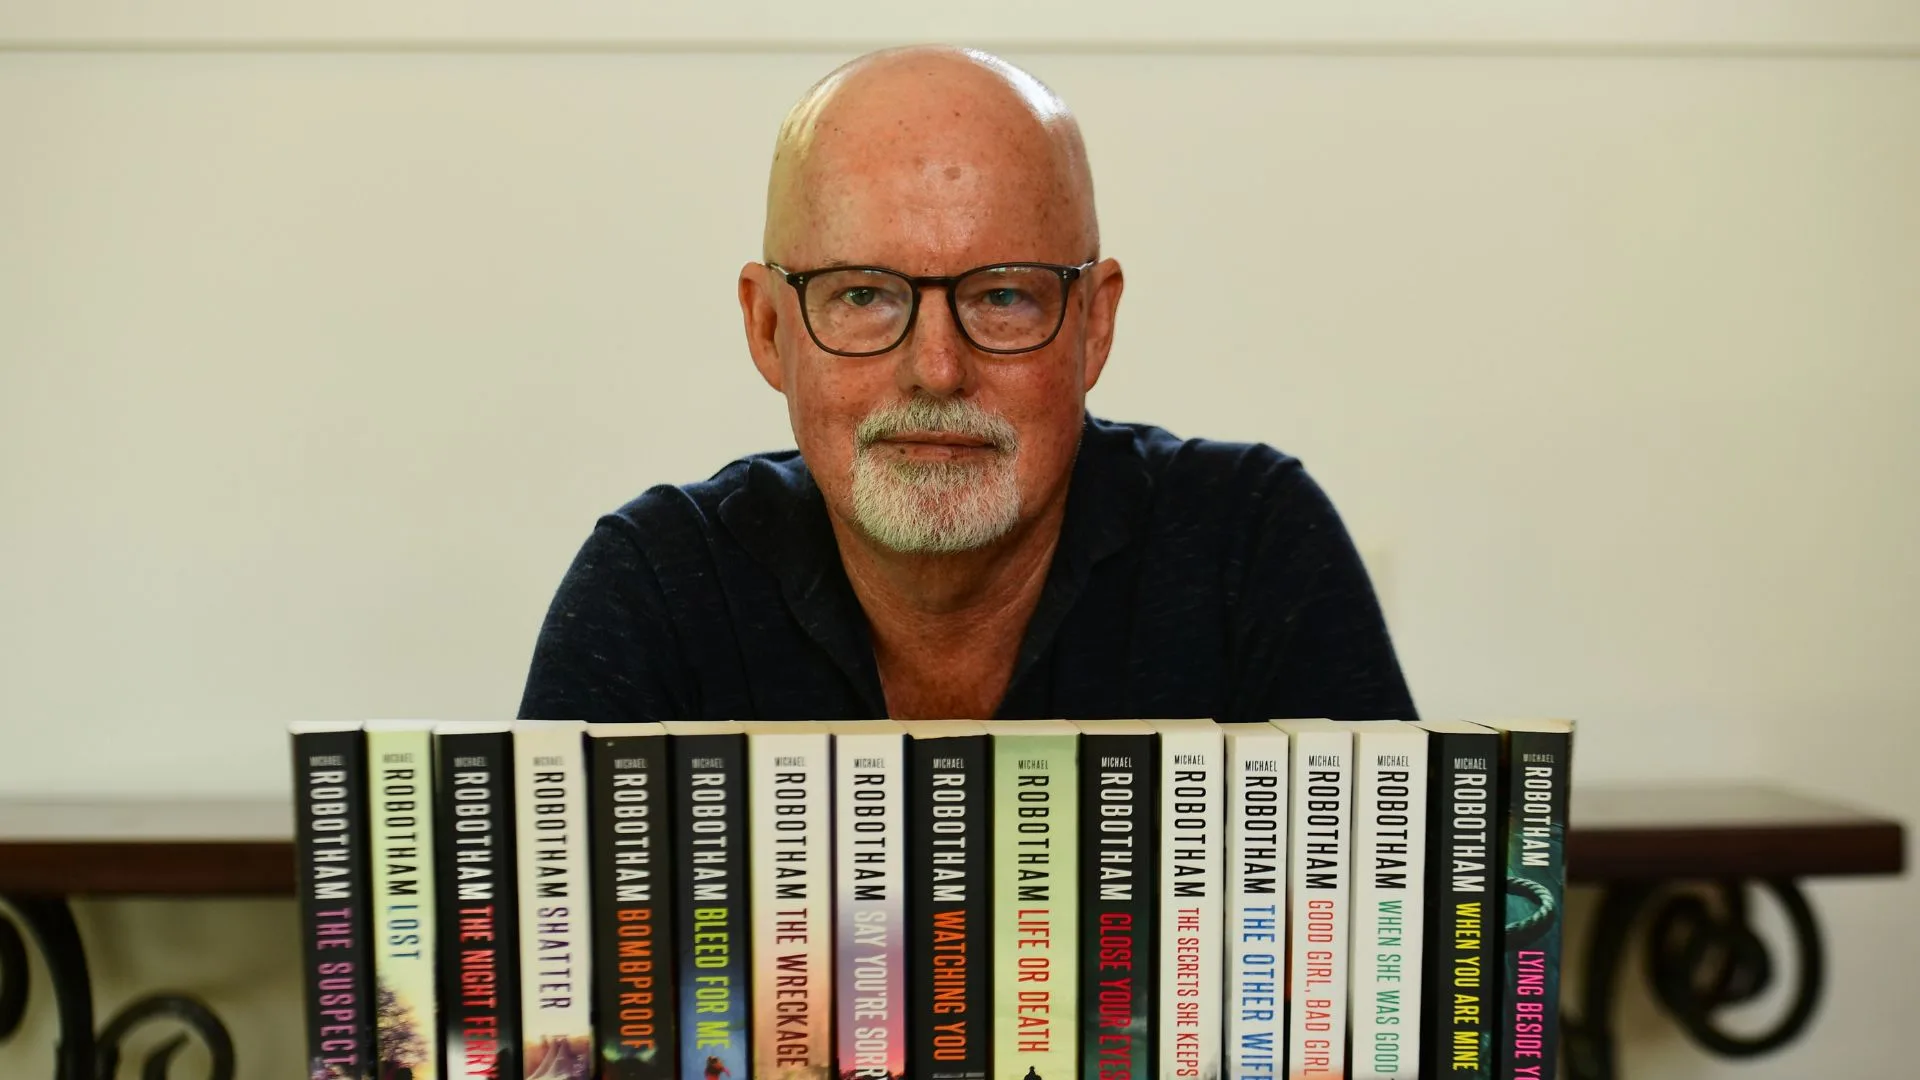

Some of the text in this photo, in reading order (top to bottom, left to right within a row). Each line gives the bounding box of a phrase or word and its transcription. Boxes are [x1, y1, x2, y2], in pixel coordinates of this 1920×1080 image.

[691, 758, 723, 768] MICHAEL
[775, 757, 805, 767] MICHAEL
[854, 758, 885, 768] MICHAEL
[933, 758, 965, 769] MICHAEL
[1018, 760, 1049, 770] MICHAEL
[1101, 757, 1132, 768] MICHAEL
[1174, 755, 1205, 765] MICHAEL
[1245, 760, 1277, 772] MICHAEL
[1308, 755, 1340, 766] MICHAEL
[1377, 755, 1409, 766] MICHAEL
[1454, 758, 1487, 770] MICHAEL
[1523, 753, 1555, 763] MICHAEL
[933, 774, 966, 902] ROBOTHAM
[1100, 773, 1132, 901] ROBOTHAM
[1243, 776, 1277, 894] ROBOTHAM
[1521, 767, 1553, 866] ROBOTHAM
[383, 769, 422, 960] ROBOTHAM LOST
[534, 772, 574, 1010] ROBOTHAM SHATTER
[310, 771, 356, 1066] ROBOTHAM THE SUSPECT
[454, 772, 499, 1080] ROBOTHAM THE NIGHT FERRY
[613, 774, 654, 1050] ROBOTHAM BOMBPROOF
[692, 774, 731, 1050] ROBOTHAM BLEED FOR ME
[775, 773, 809, 1068] ROBOTHAM THE WRECKAGE
[853, 774, 889, 1080] ROBOTHAM SAY YOU'RE SORR
[1018, 776, 1050, 1053] ROBOTHAM LIFE OR DEATH
[1099, 913, 1132, 971] CLOSE
[1174, 771, 1205, 1077] ROBOTHAM THE SECRETS SHE KEEPS
[1242, 906, 1275, 942] THE
[1304, 771, 1340, 1076] ROBOTHAM GOOD GIRL, BAD GIRL
[1375, 771, 1409, 1073] ROBOTHAM WHEN SHE WAS GOOD
[1452, 774, 1487, 1071] ROBOTHAM WHEN YOU ARE MINE
[933, 911, 966, 1014] WATCHING
[1241, 954, 1275, 1021] OTHER
[1517, 951, 1545, 996] LYING
[1099, 978, 1132, 1027] YOUR
[1514, 1001, 1543, 1059] BESIDE
[933, 1020, 966, 1062] YOU
